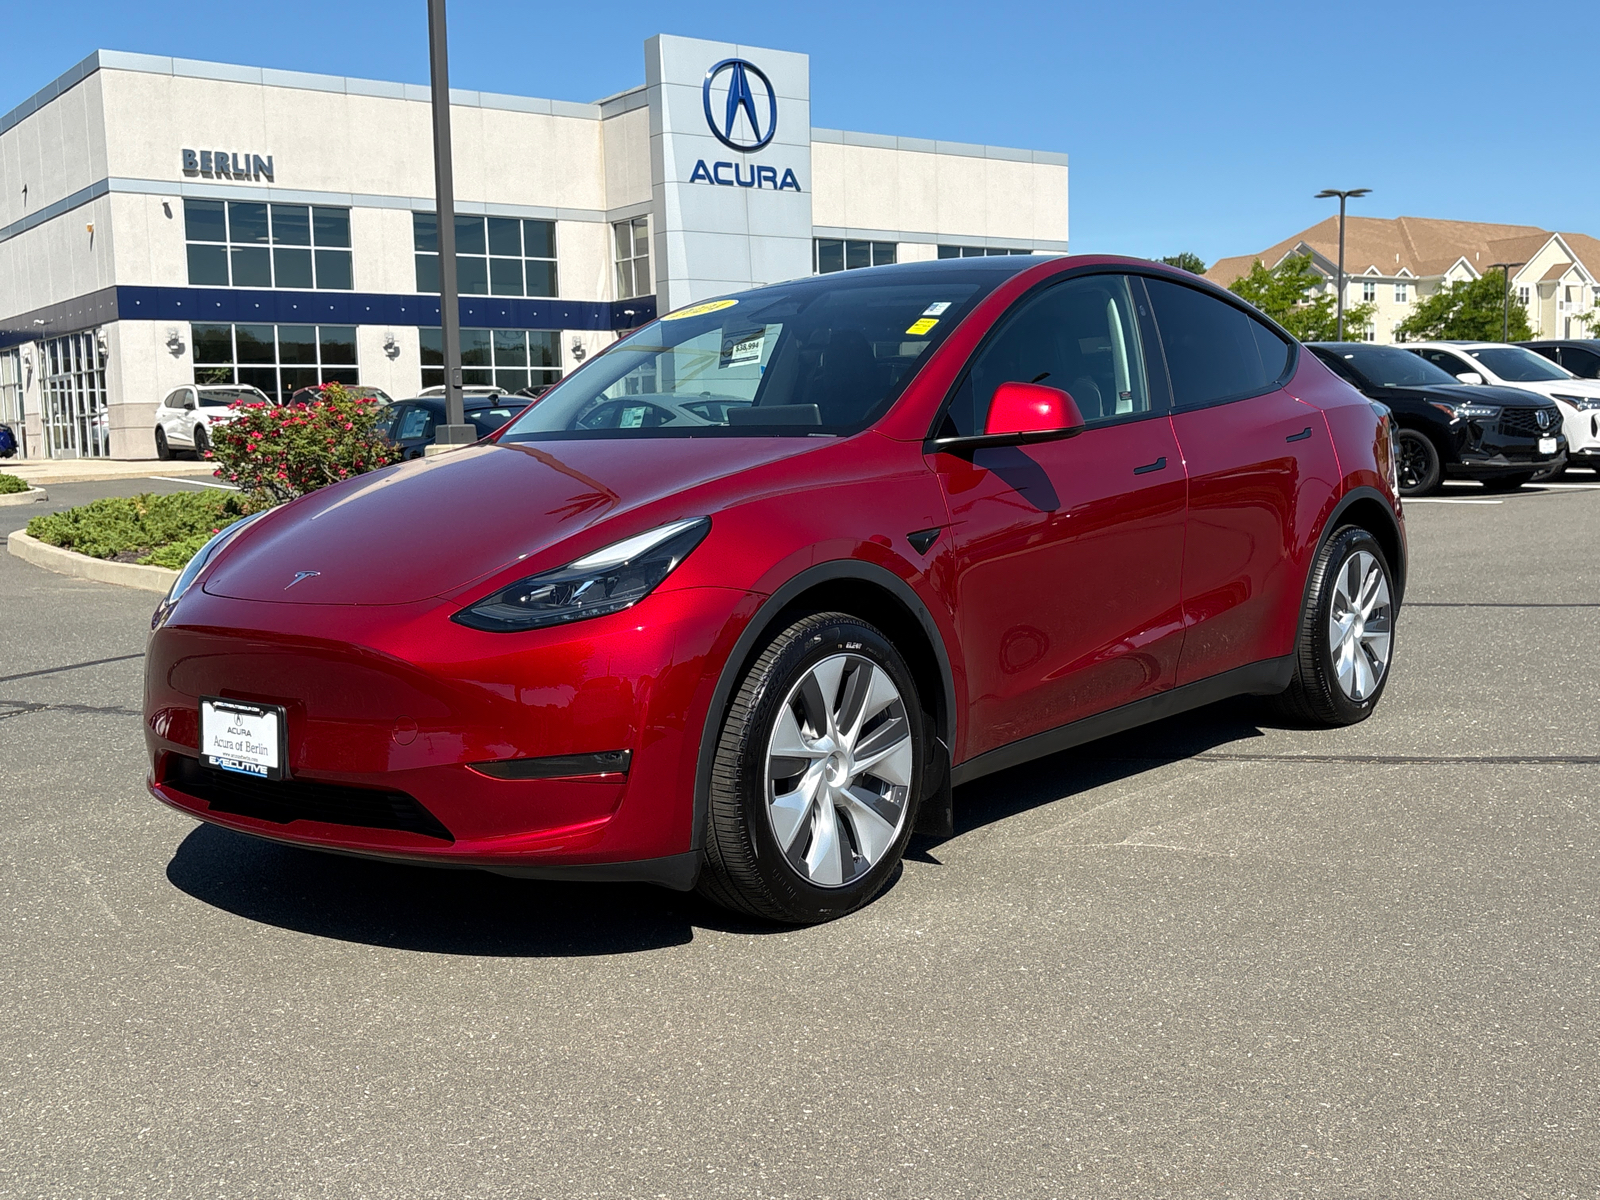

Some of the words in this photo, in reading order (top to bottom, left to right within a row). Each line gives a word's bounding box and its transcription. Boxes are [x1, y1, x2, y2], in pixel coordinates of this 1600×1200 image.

[182, 149, 274, 182] BERLIN
[689, 159, 801, 192] ACURA
[735, 341, 759, 352] $38,994
[227, 726, 252, 737] ACURA
[213, 735, 233, 749] Acura
[235, 741, 243, 751] of
[245, 741, 268, 755] Berlin
[209, 756, 268, 775] EXECUTIVE
